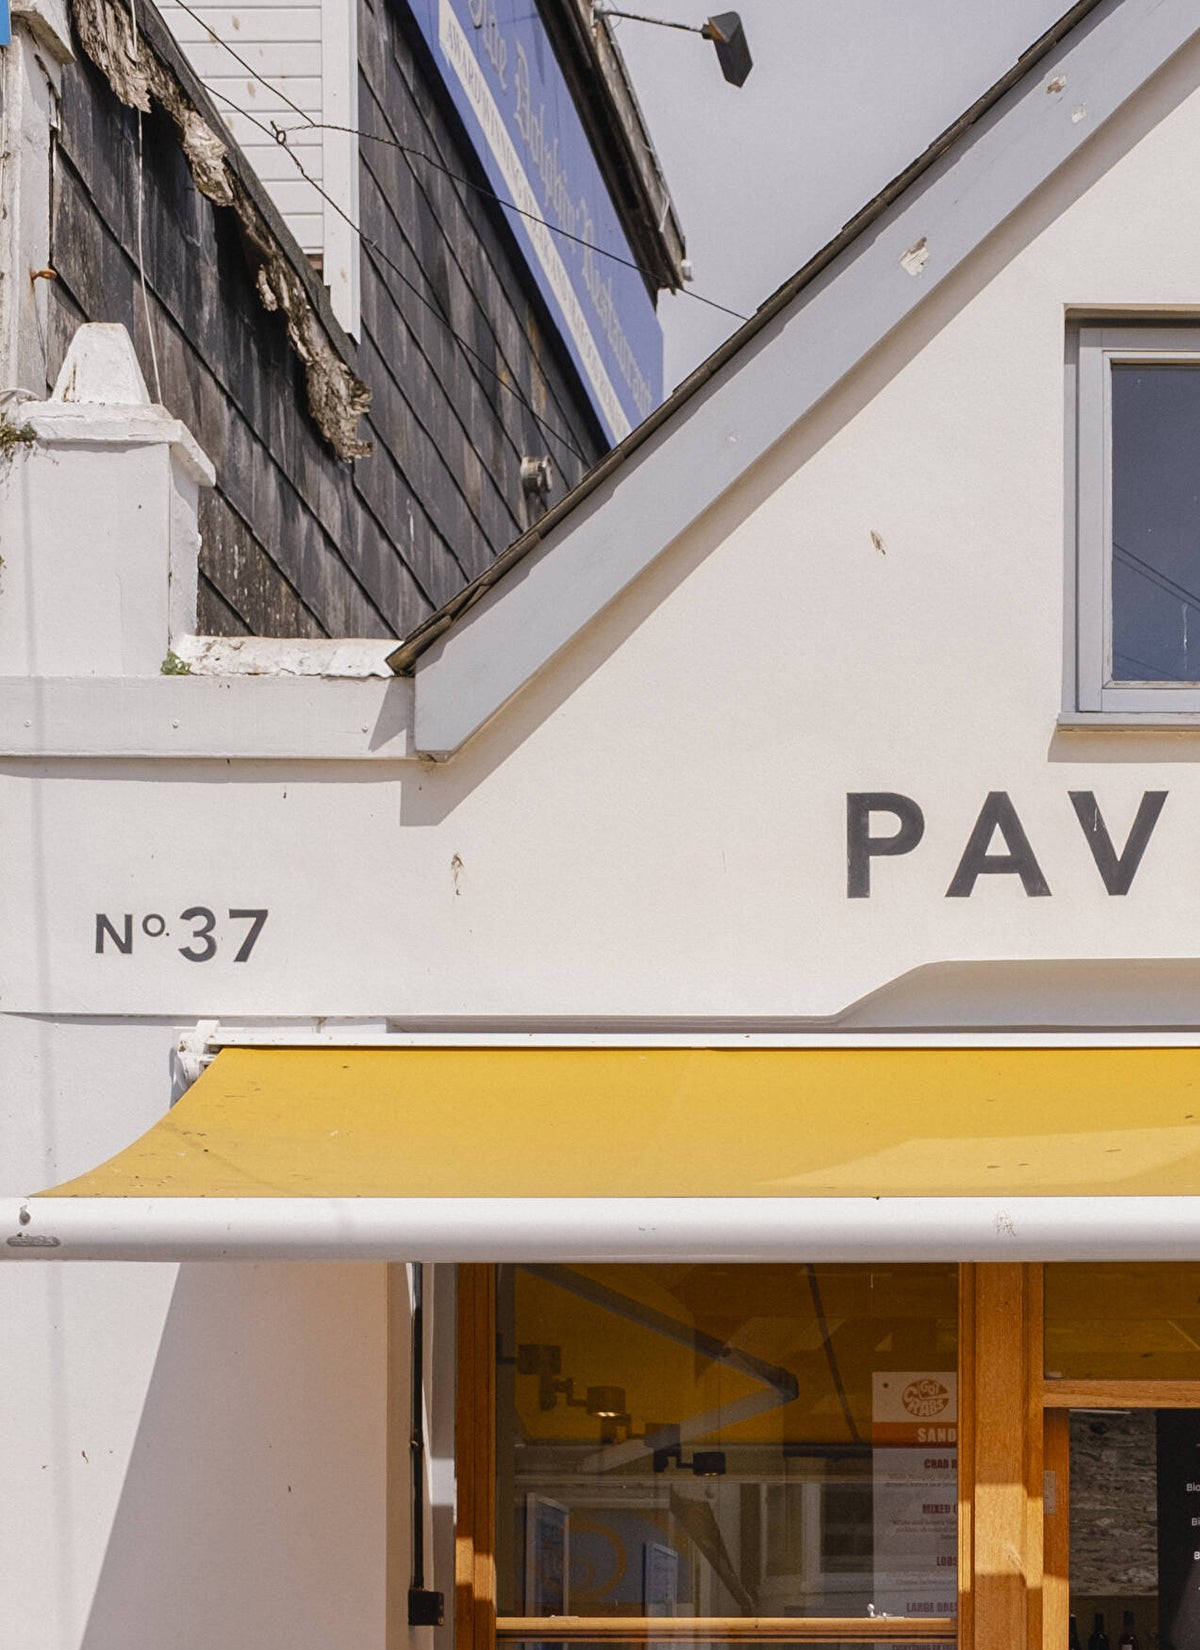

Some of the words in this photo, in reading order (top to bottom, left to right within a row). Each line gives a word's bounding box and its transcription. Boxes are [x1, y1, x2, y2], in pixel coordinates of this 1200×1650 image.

[920, 1380, 940, 1396] GOT
[904, 1386, 945, 1416] CRABS
[924, 1459, 949, 1469] CRAB
[922, 1504, 951, 1514] MIXED
[906, 1603, 934, 1613] LARGE
